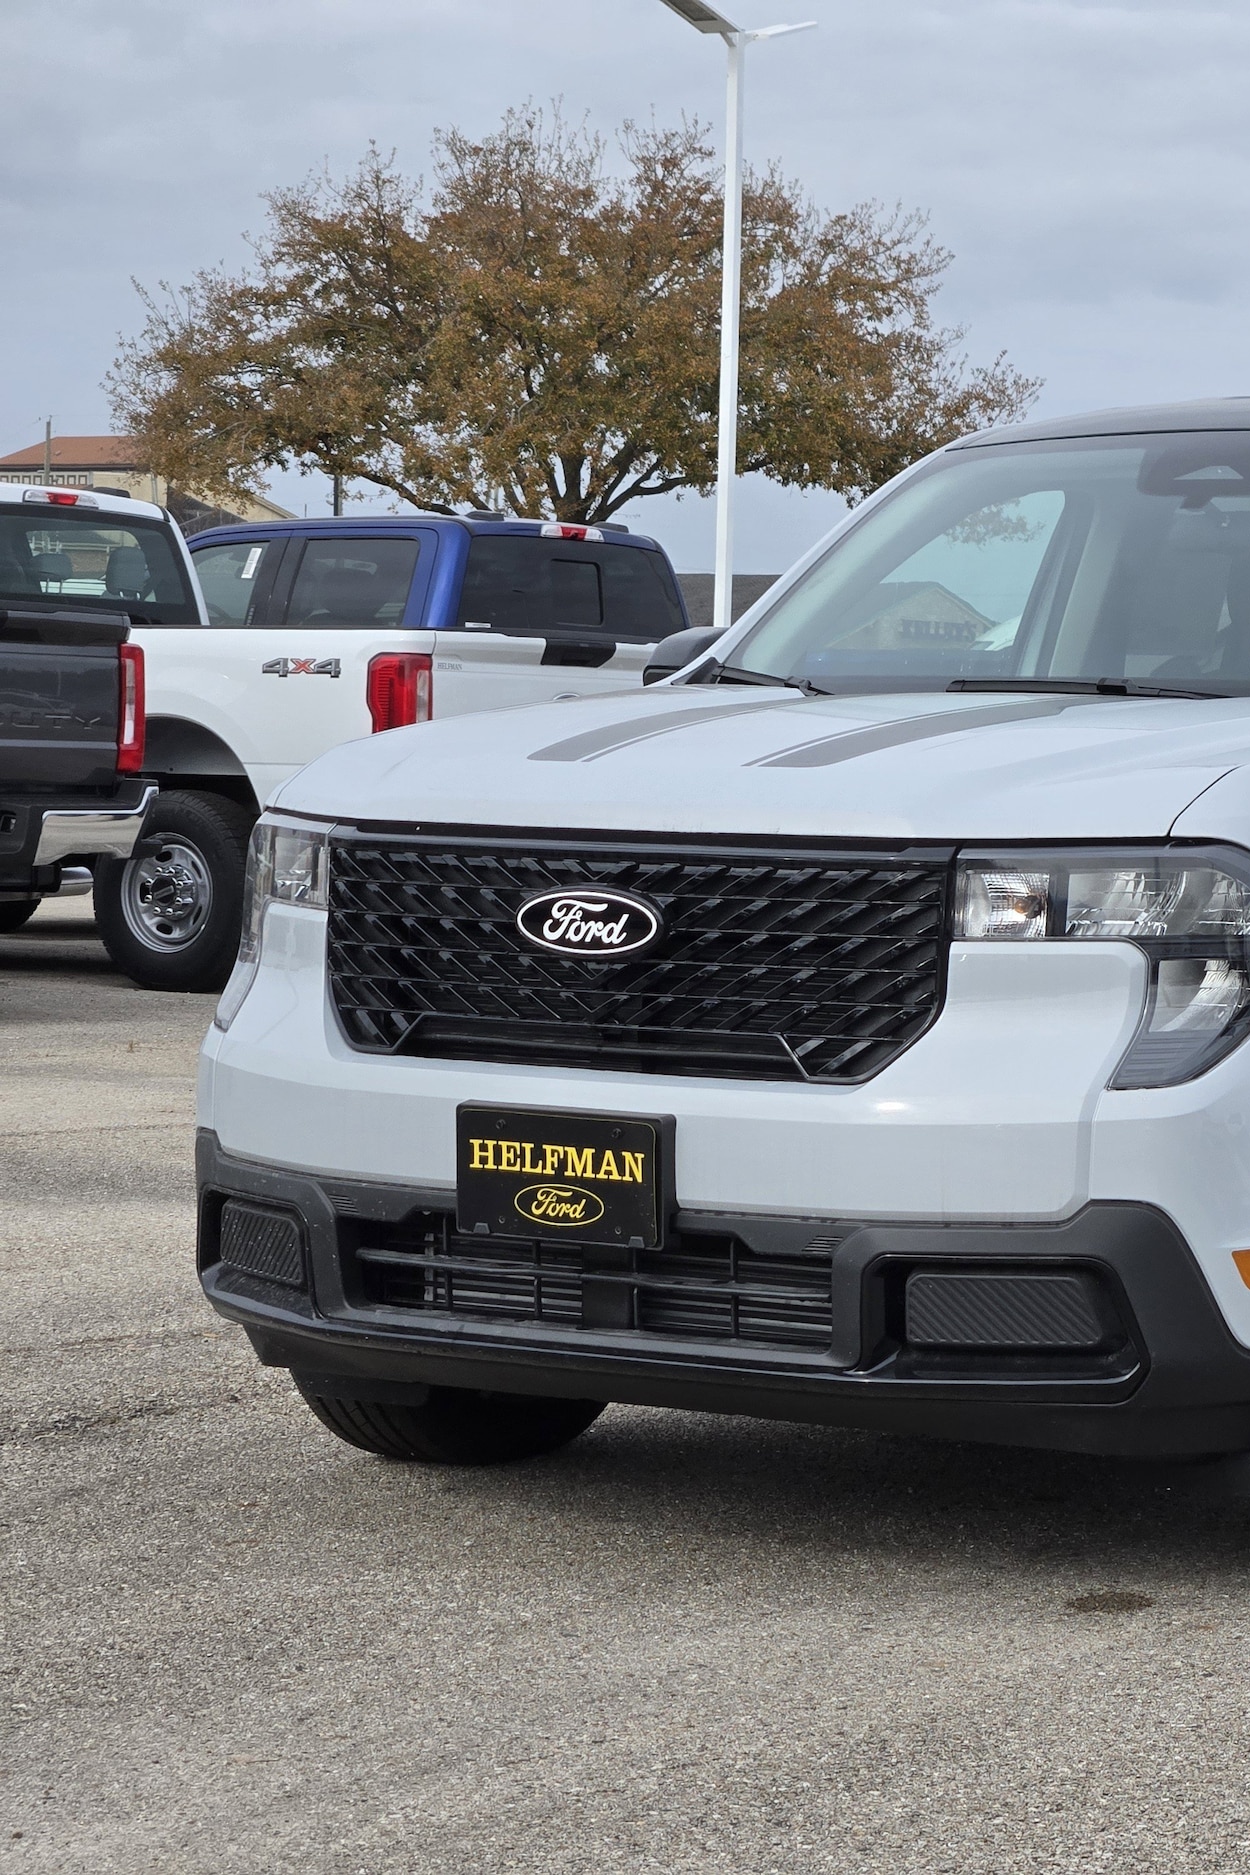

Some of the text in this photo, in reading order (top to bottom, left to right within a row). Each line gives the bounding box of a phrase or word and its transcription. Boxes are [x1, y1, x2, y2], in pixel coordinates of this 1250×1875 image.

[437, 662, 463, 671] HELFMAN
[0, 712, 102, 731] UTY
[542, 899, 630, 944] Ford
[469, 1139, 645, 1183] HELFMAN
[531, 1188, 587, 1219] Ford
